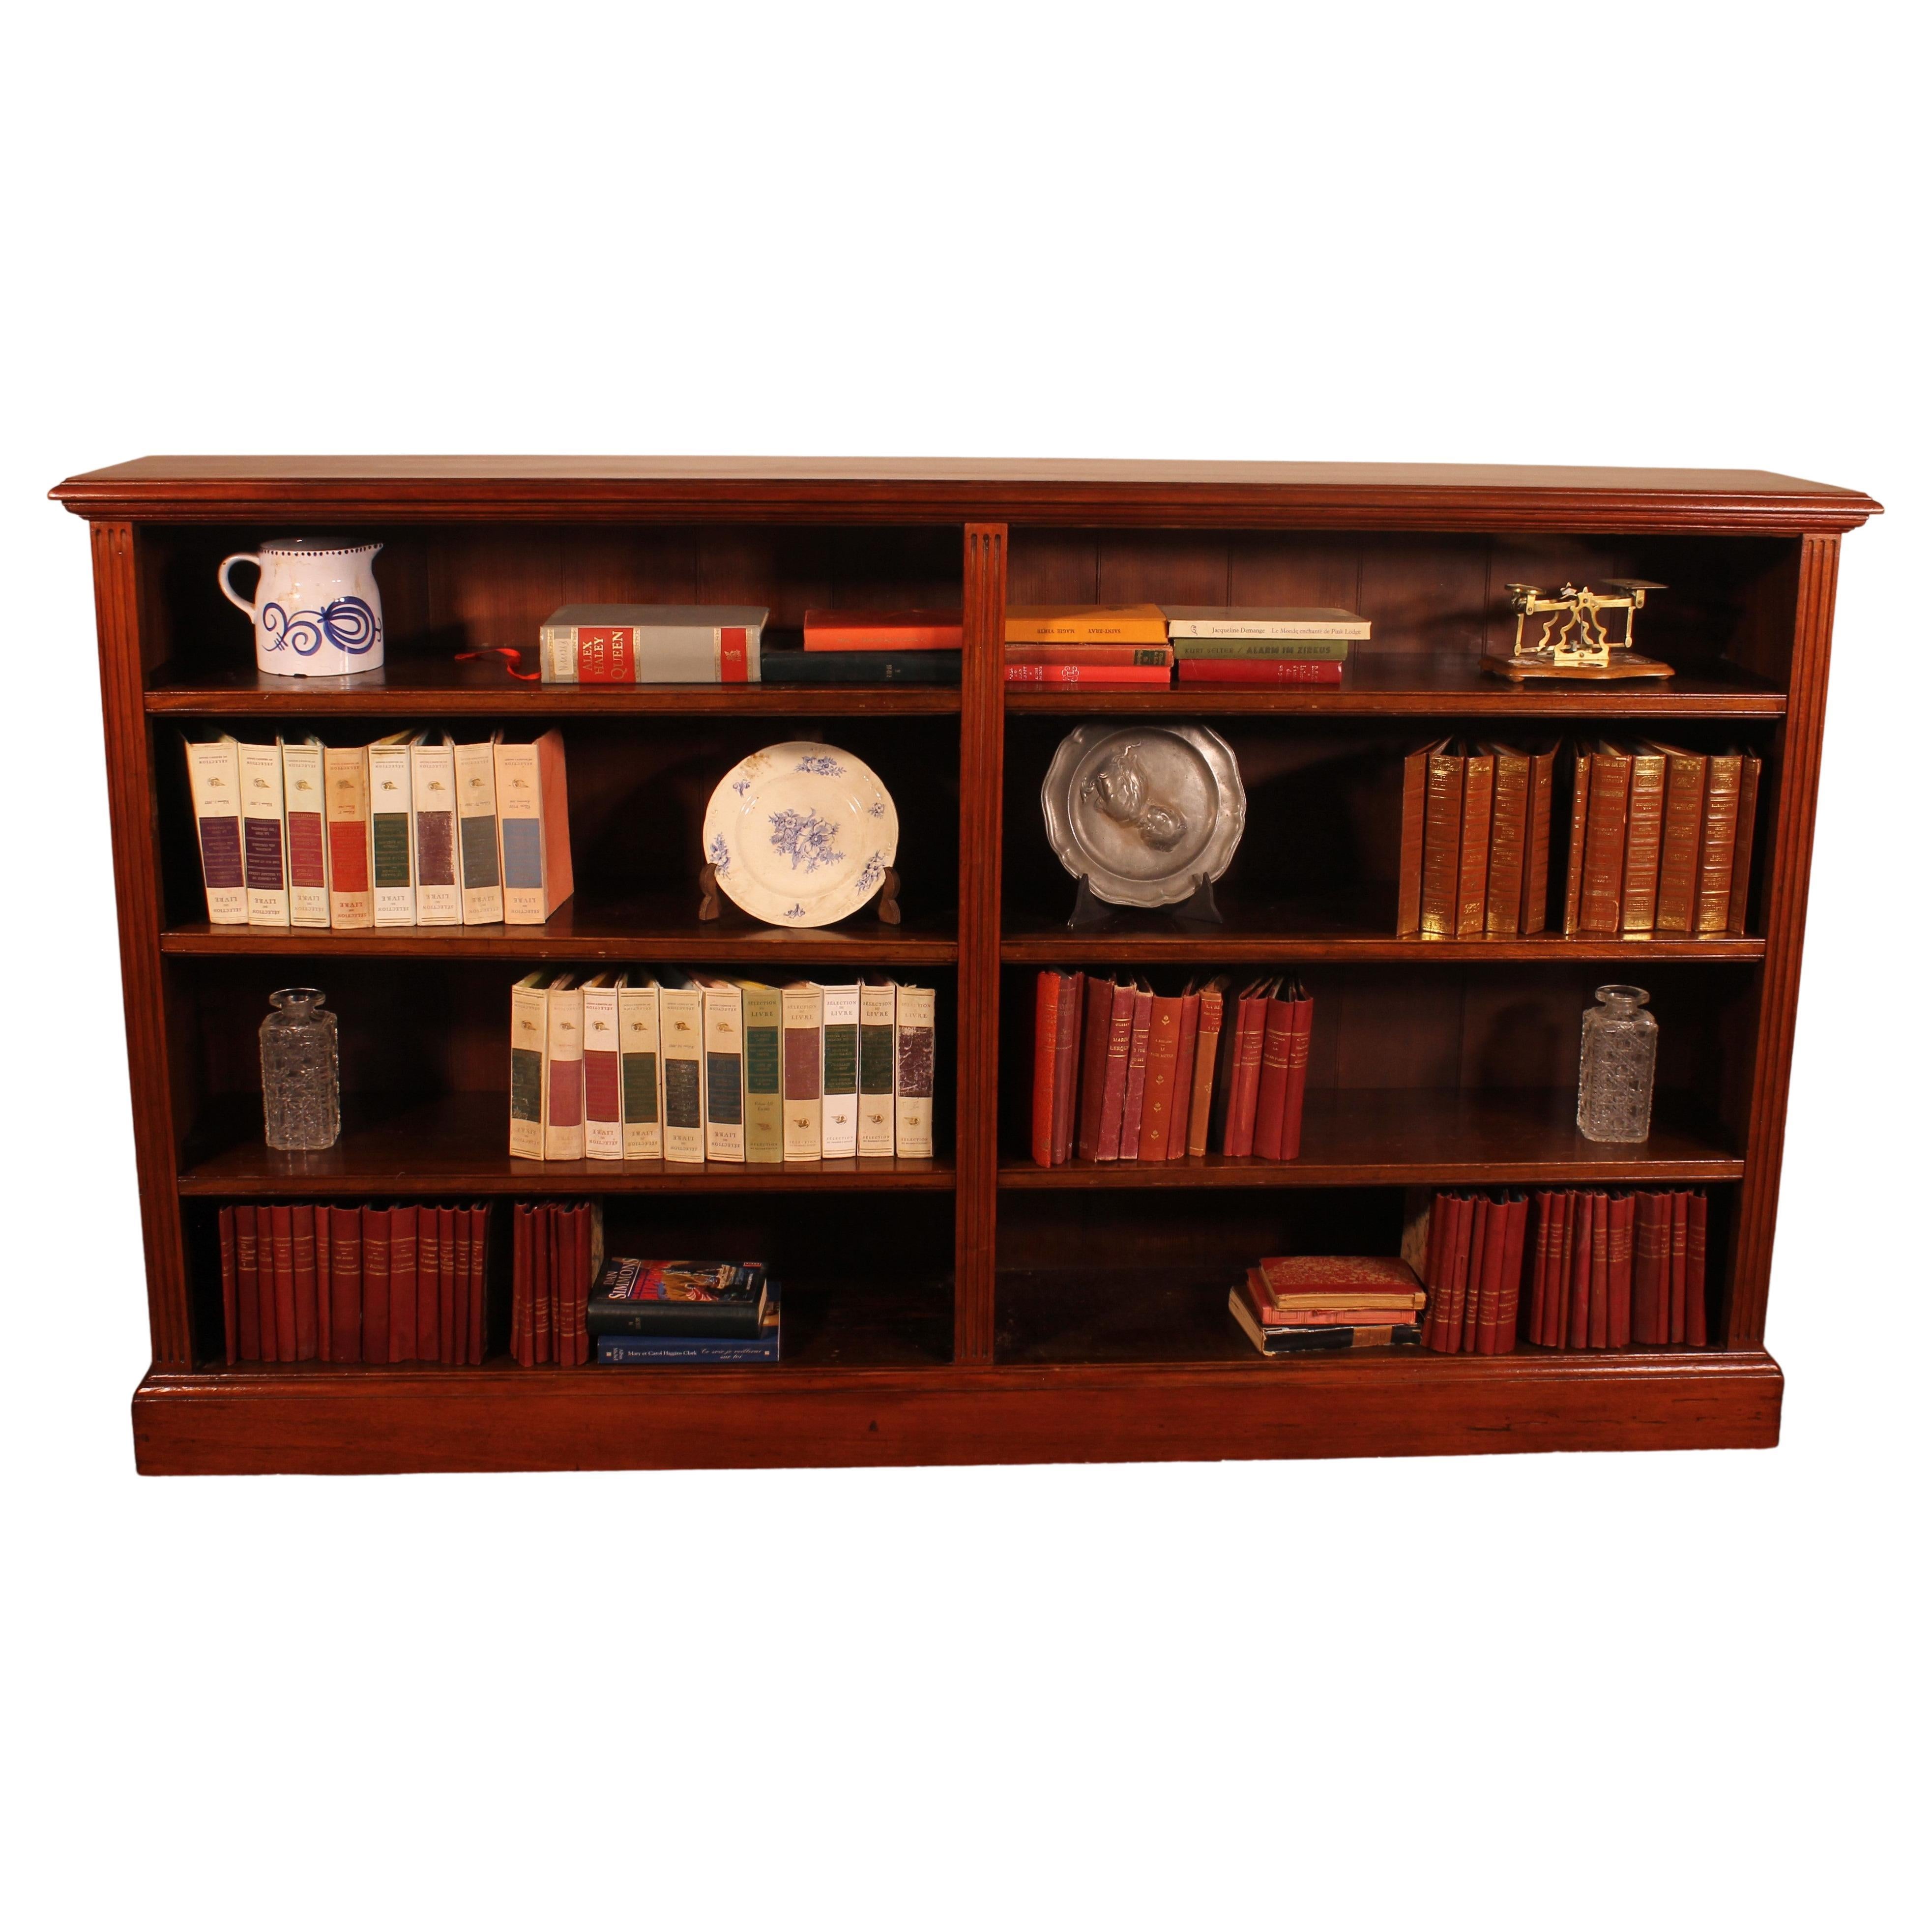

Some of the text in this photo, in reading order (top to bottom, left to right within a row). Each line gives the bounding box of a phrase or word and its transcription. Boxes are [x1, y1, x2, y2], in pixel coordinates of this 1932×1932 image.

[583, 641, 592, 671] ALEX
[594, 637, 604, 675] HALEY
[611, 631, 627, 679] QUEEN
[603, 1271, 618, 1285] DAN
[609, 1258, 639, 1299] SIMMONS
